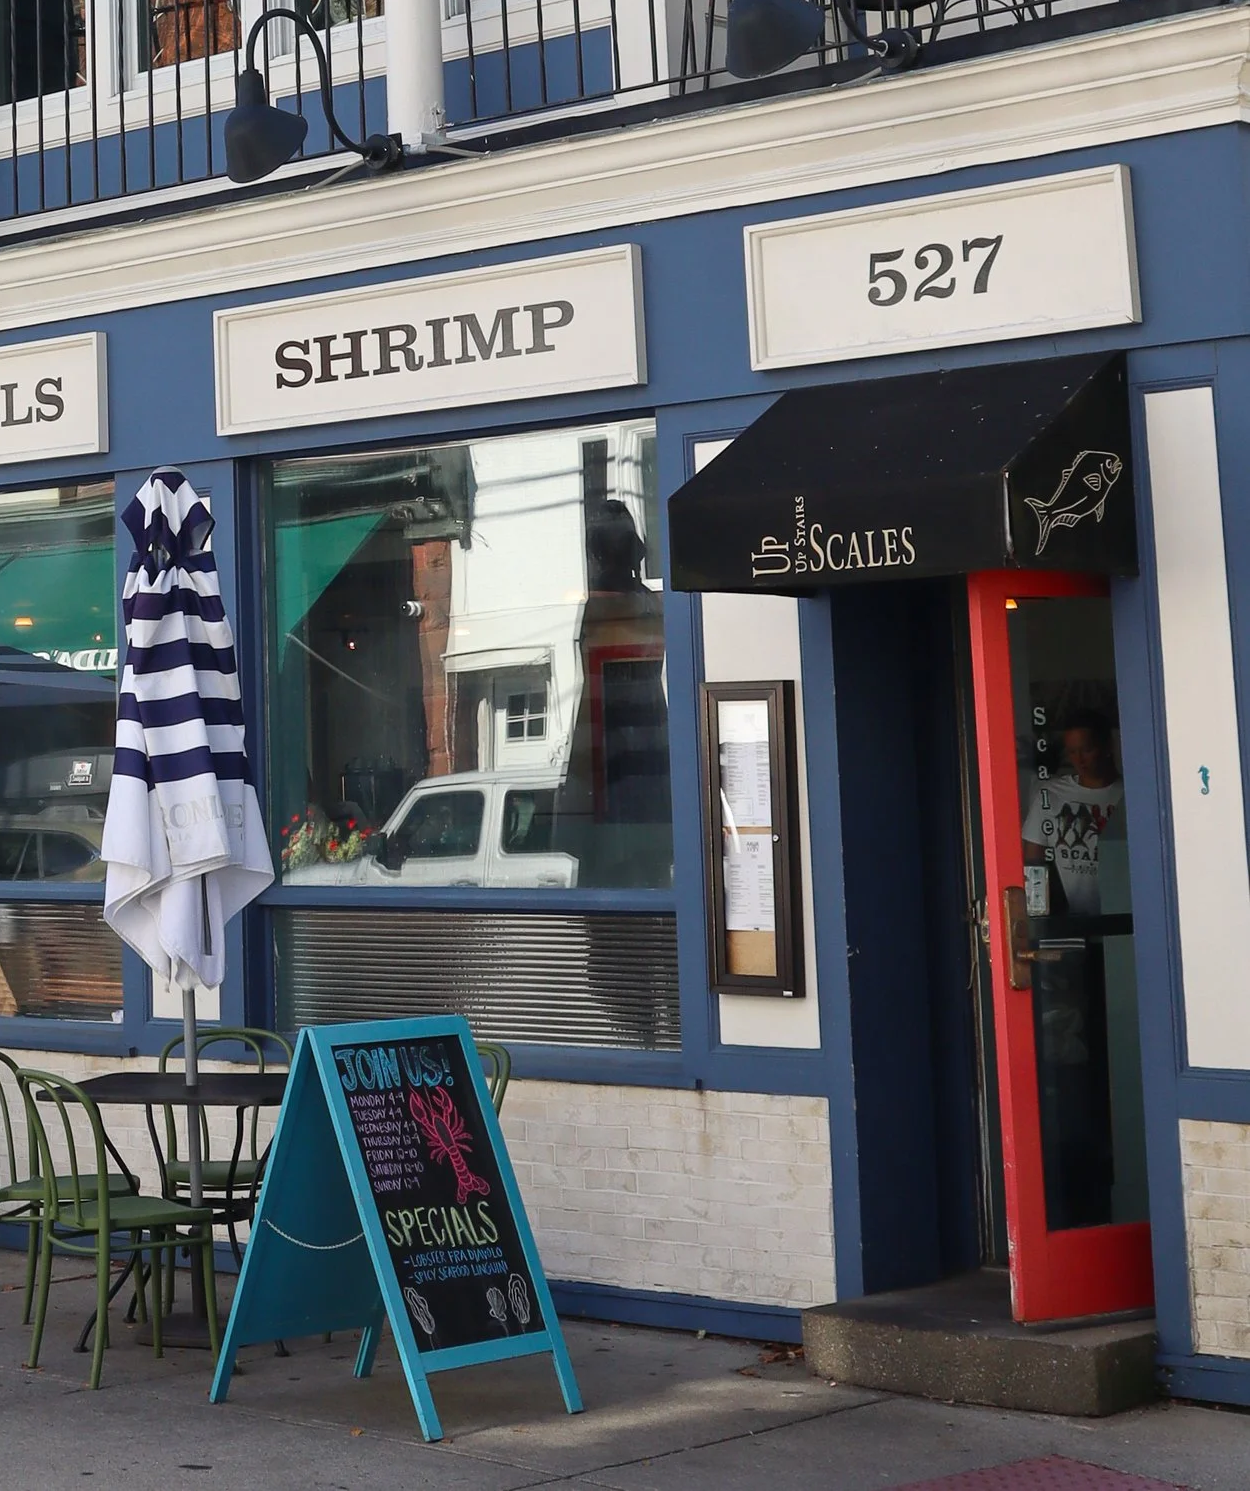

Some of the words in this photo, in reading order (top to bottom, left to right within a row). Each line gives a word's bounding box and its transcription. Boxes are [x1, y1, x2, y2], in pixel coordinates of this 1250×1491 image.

[867, 234, 1004, 307] 527
[275, 299, 575, 389] SHRIMP
[809, 523, 916, 572] SCALES
[1033, 706, 1055, 861] Scales
[335, 1047, 401, 1091] JOIN
[400, 1043, 454, 1087] US!
[350, 1094, 386, 1108] MONDAY
[353, 1109, 387, 1122] TUESDAY
[357, 1121, 401, 1135] WEDNESDAY
[362, 1135, 401, 1148] THURSDAY
[366, 1150, 394, 1162] FRIDAY
[395, 1148, 418, 1160] 12-10
[374, 1178, 401, 1193] SUNDAY
[385, 1201, 498, 1247] SPECIALS
[448, 1249, 468, 1263] FRA
[438, 1265, 470, 1281] SEAFOOD
